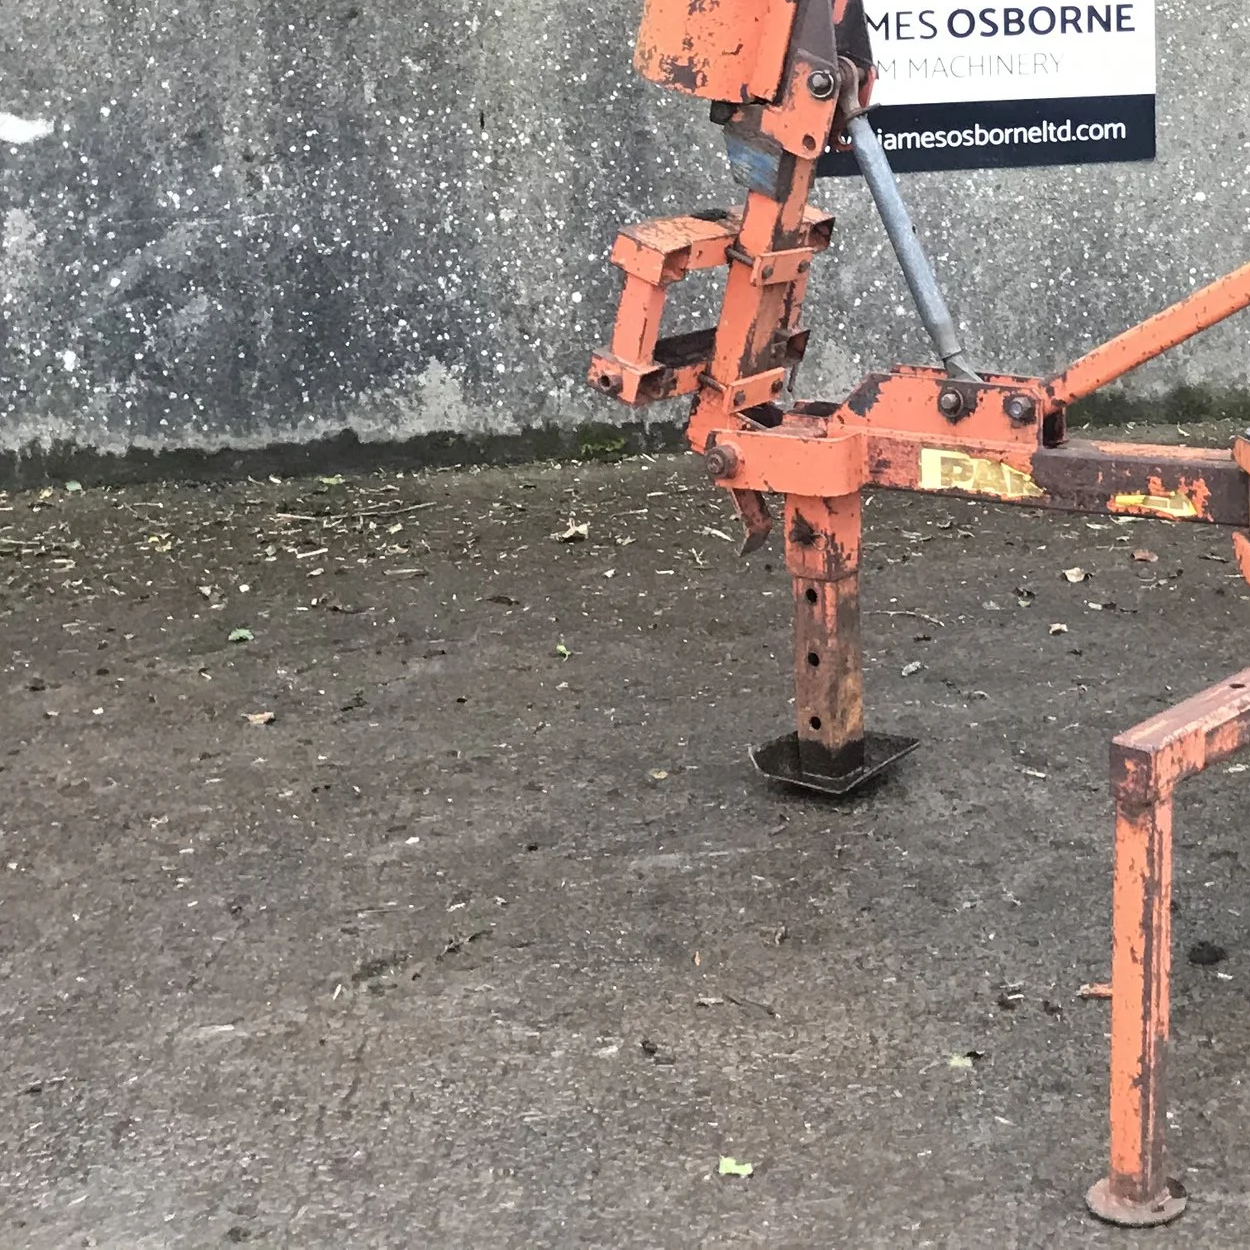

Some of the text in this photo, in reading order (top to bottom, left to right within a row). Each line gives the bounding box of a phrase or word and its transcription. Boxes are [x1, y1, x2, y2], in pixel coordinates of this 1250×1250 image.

[865, 3, 1136, 41] MES OSBORNE
[877, 52, 1064, 80] M MACHINERY
[824, 119, 1127, 154] jamesosborneltd.com
